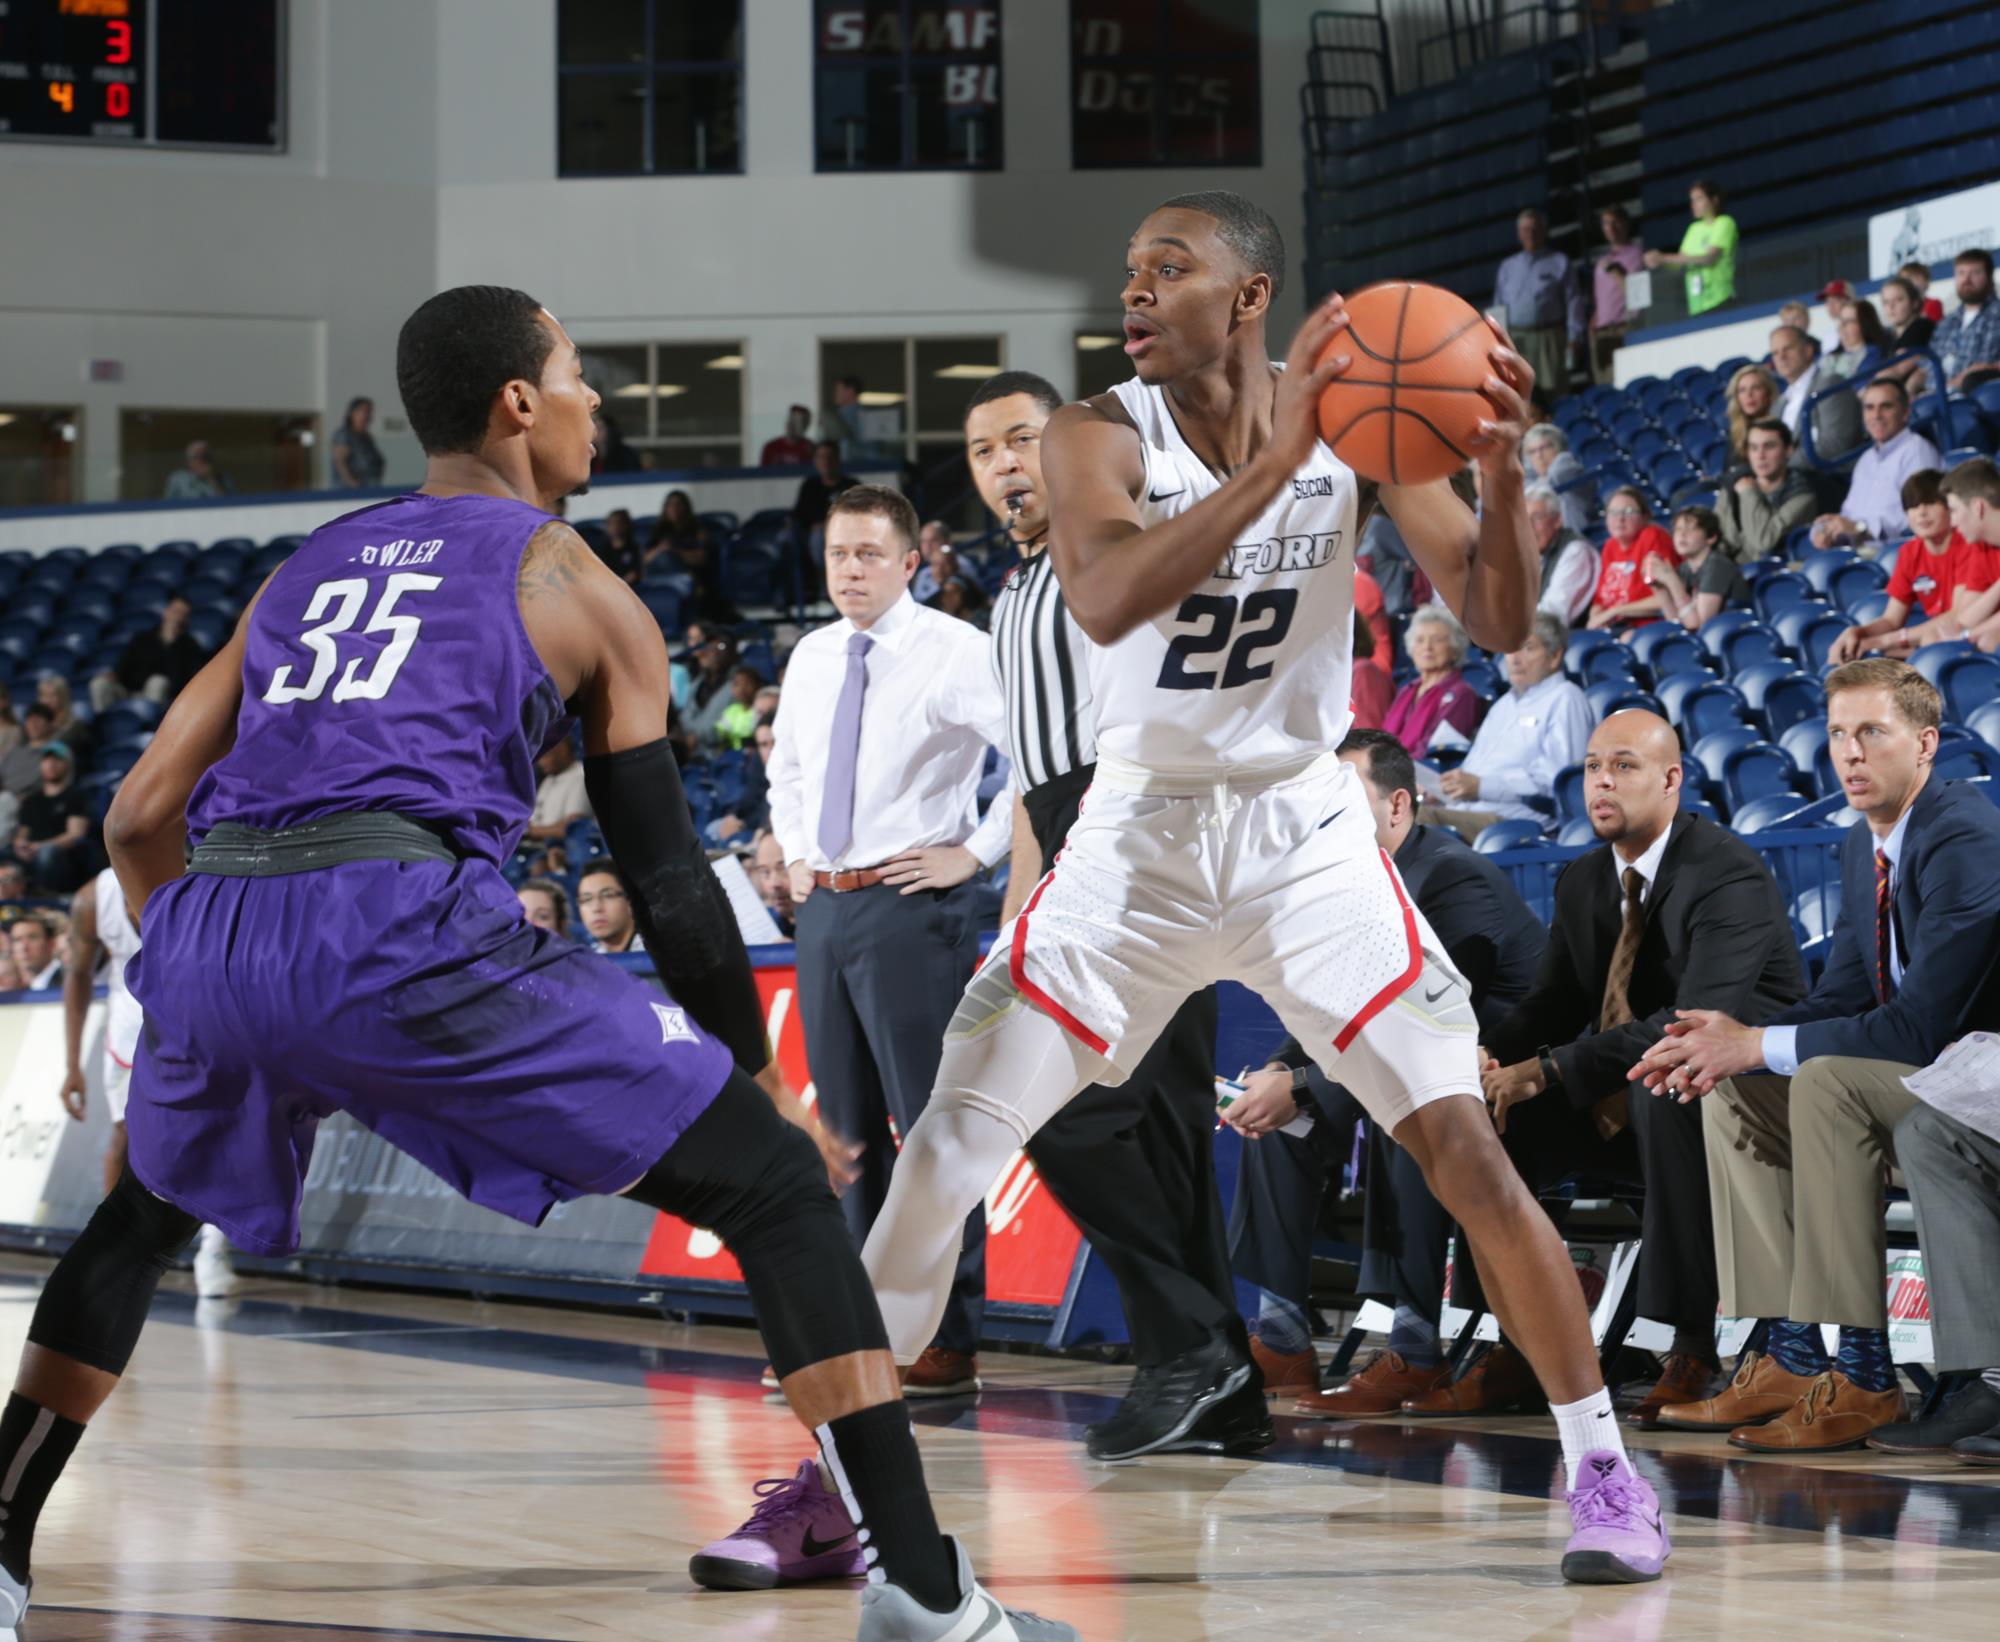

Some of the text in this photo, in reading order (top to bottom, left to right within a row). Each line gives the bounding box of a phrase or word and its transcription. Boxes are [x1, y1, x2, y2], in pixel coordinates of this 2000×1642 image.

[106, 20, 131, 64] 3
[49, 82, 73, 113] 4
[106, 82, 130, 117] 0
[348, 539, 444, 566] OWLER
[262, 572, 444, 704] 35
[1156, 588, 1298, 690] 22
